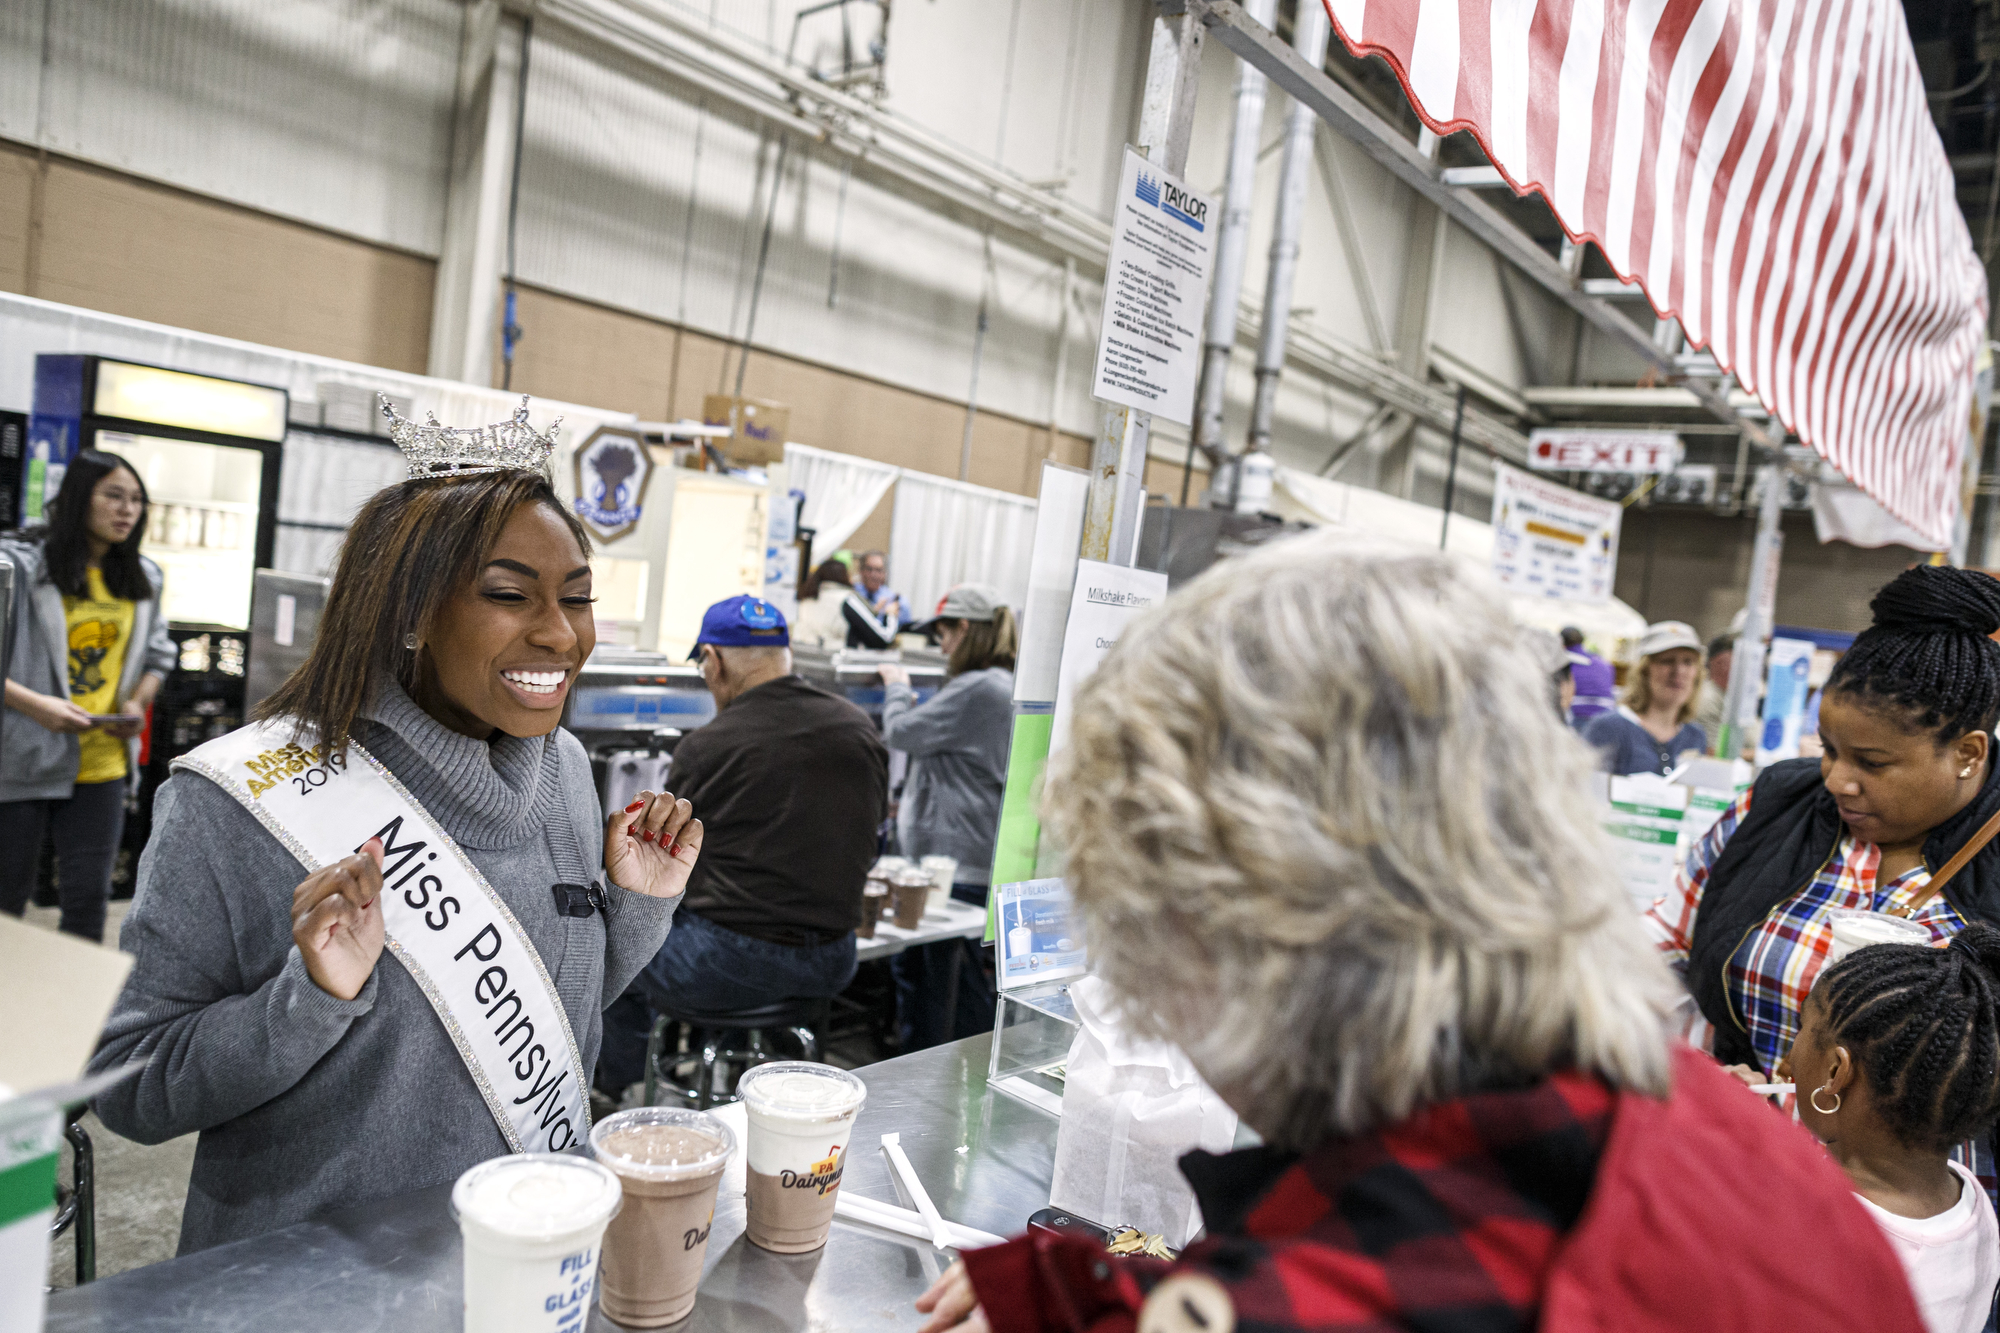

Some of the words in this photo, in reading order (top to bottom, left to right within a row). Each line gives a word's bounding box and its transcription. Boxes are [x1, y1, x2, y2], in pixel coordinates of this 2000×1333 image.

[1164, 182, 1206, 222] TAYLOR
[1120, 280, 1136, 291] Frozen
[1131, 274, 1144, 284] Cream
[1146, 272, 1164, 286] Cooking
[1119, 290, 1135, 301] Frozen
[1127, 304, 1140, 314] Cream
[1115, 320, 1125, 328] Milk
[1126, 324, 1139, 334] Shake
[1556, 438, 1664, 468] EXIT
[1087, 587, 1125, 604] Milkshake
[244, 742, 303, 775] Miss
[293, 753, 348, 796] 2019
[354, 815, 460, 931] Miss
[1028, 886, 1049, 896] GLASS
[819, 1162, 833, 1174] PA
[560, 1249, 591, 1277] FILL
